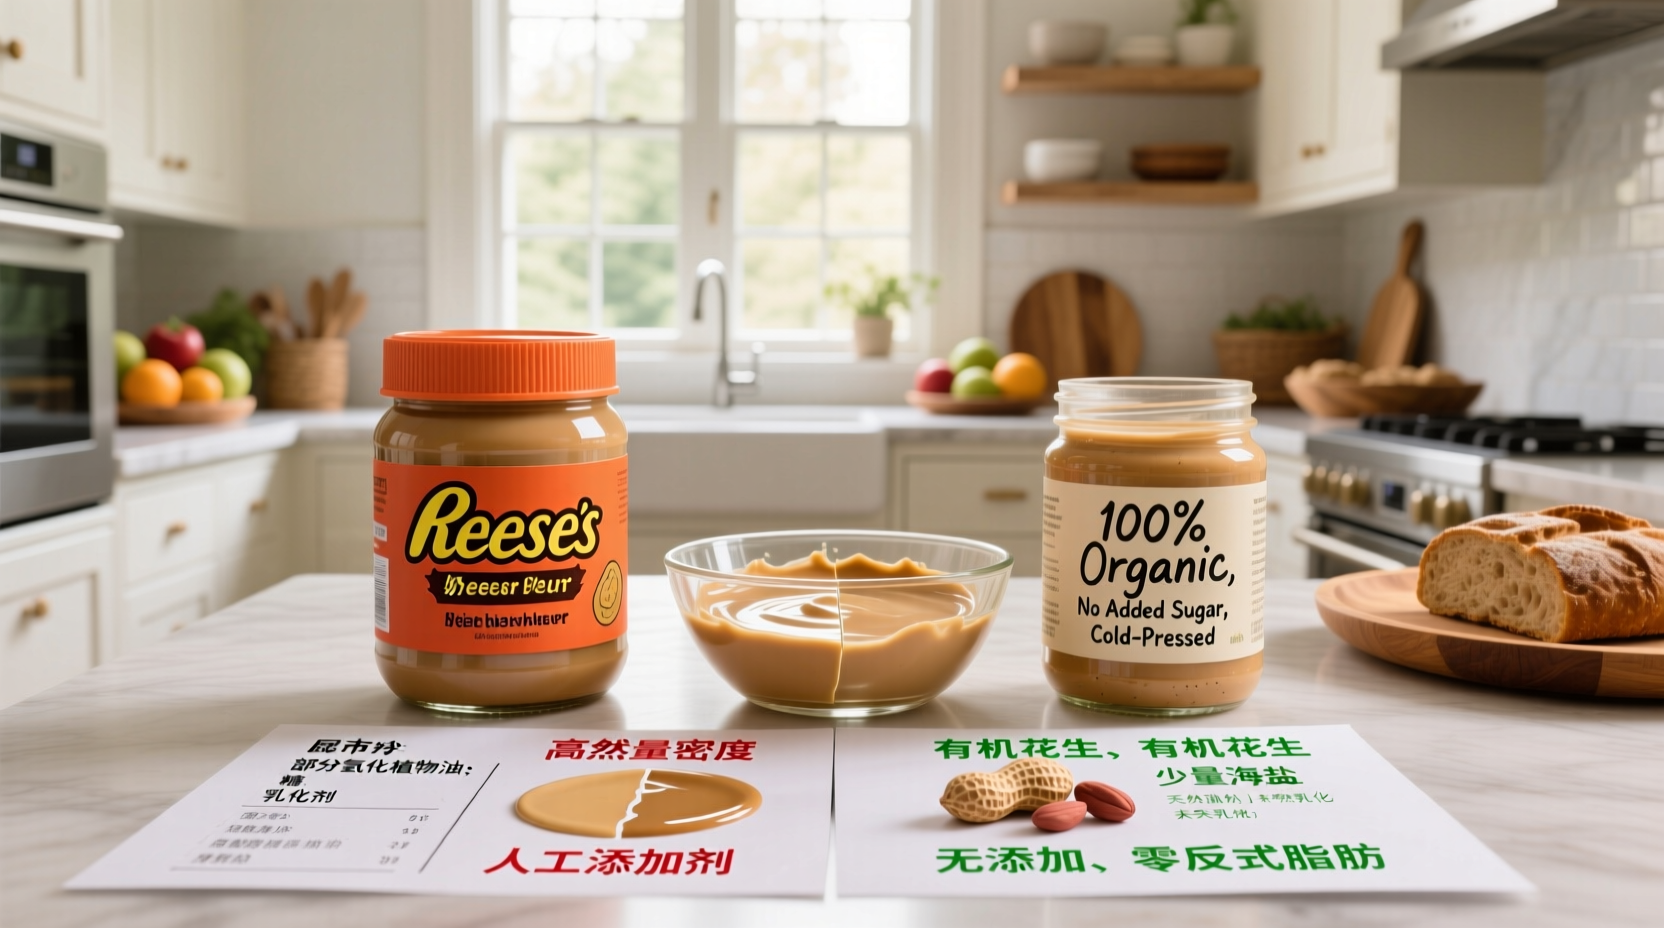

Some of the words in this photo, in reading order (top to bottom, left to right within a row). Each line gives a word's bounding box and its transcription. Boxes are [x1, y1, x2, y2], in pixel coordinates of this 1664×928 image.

[405, 482, 603, 564] Reese's
[1100, 499, 1206, 546] 100%
[1080, 541, 1235, 599] Organic,
[1078, 596, 1100, 617] No
[1105, 599, 1165, 619] Added
[1171, 600, 1228, 624] Sugar,
[1091, 624, 1215, 647] Cold-Pressed
[545, 738, 757, 762] 高然量密度
[1156, 765, 1304, 788] 少量海盐
[263, 788, 337, 803] 乳化剂
[484, 847, 734, 876] 人工添加剂
